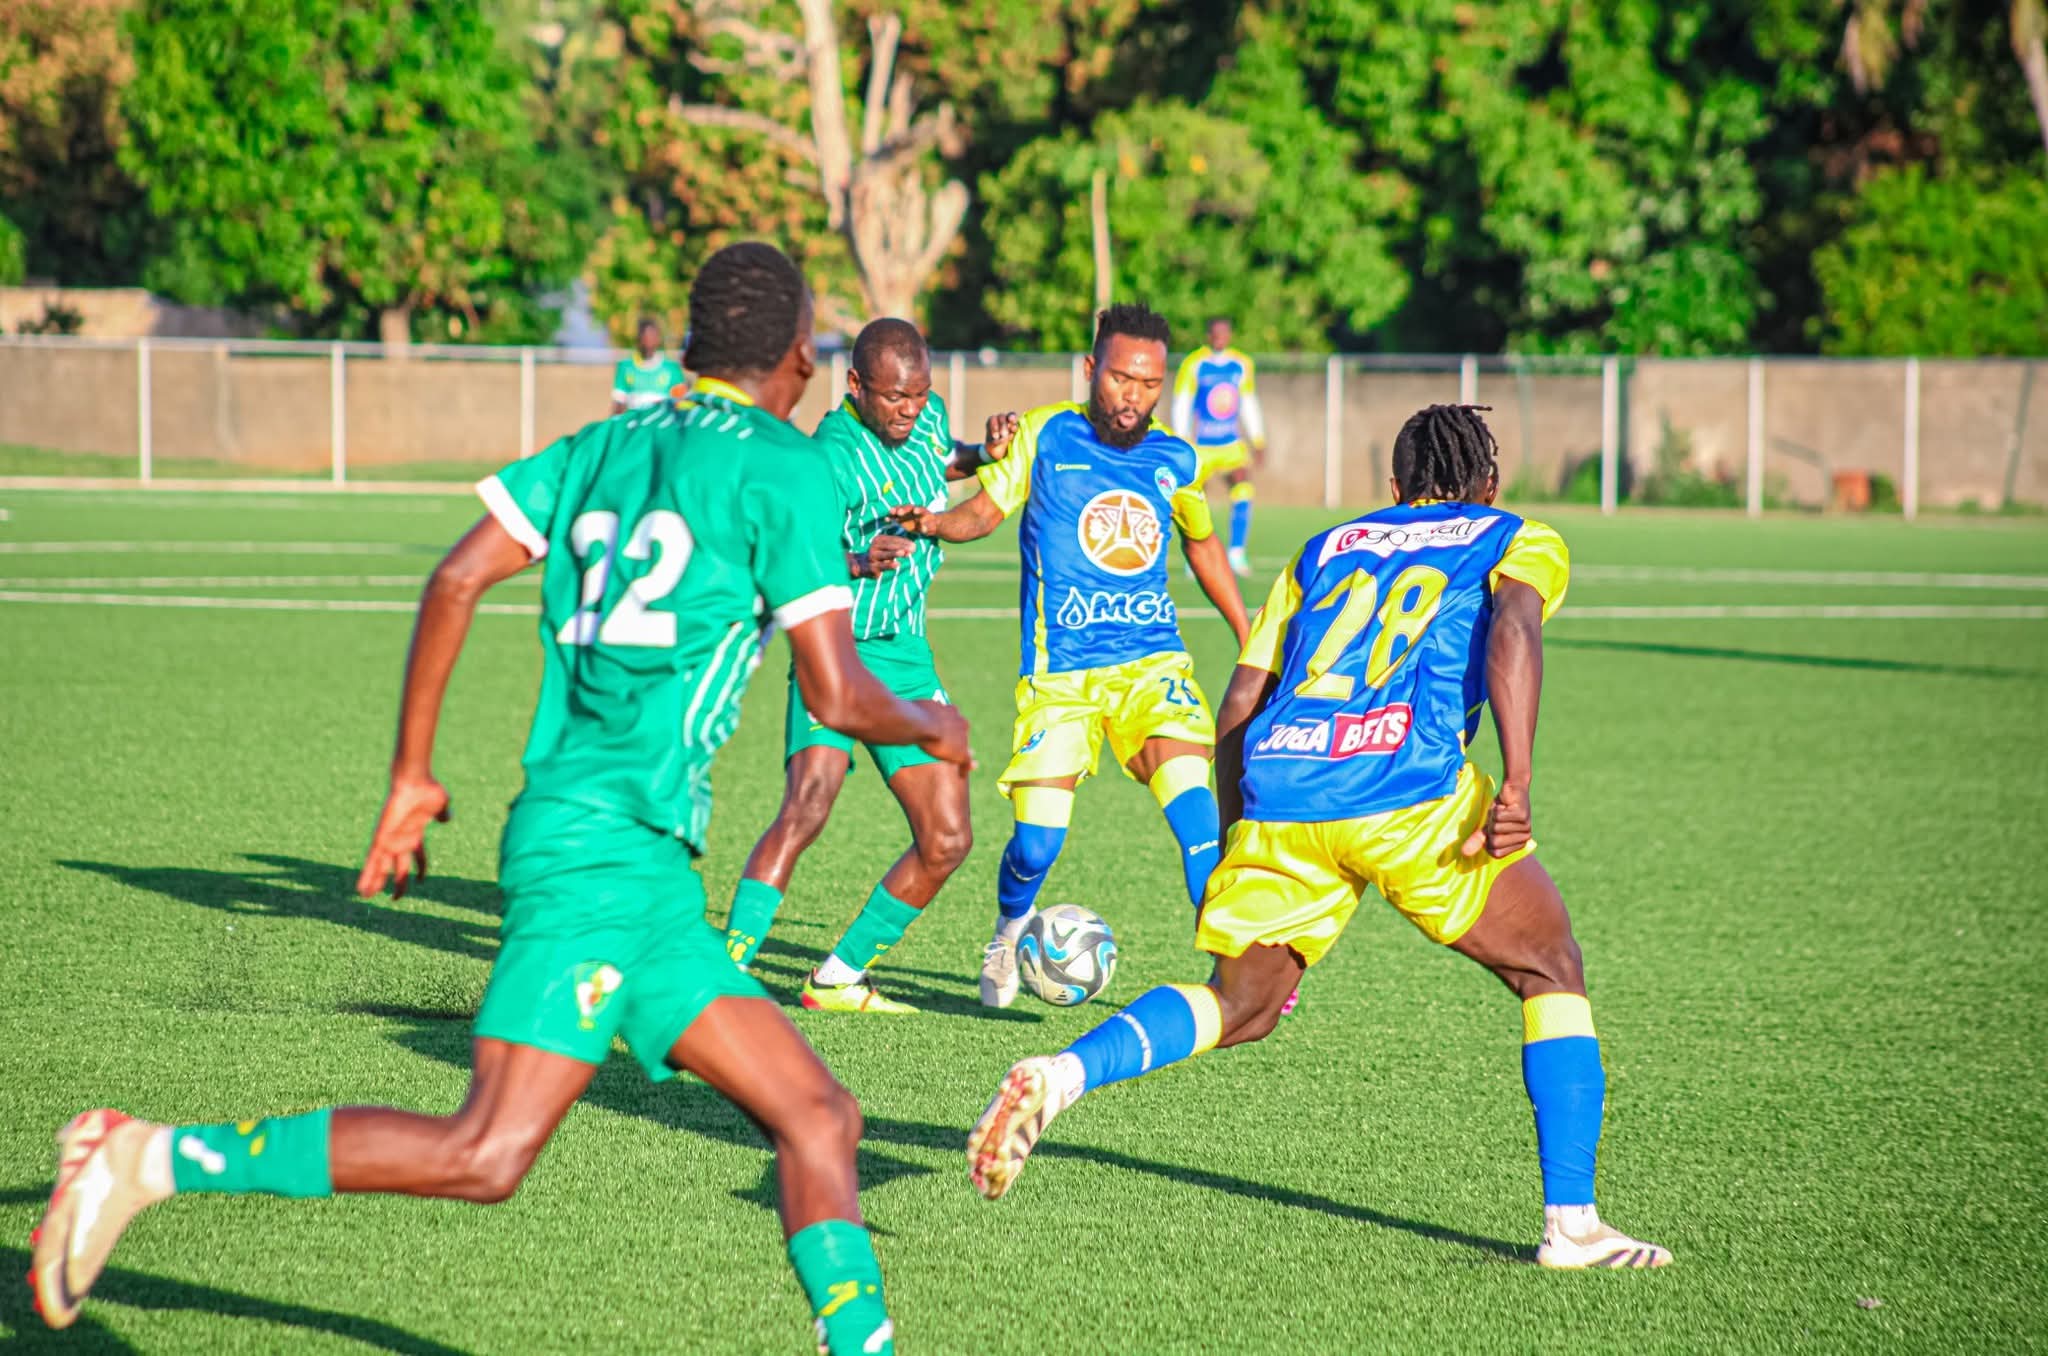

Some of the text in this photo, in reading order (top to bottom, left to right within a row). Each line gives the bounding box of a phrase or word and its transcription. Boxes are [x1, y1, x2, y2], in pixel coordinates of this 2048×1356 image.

[556, 509, 694, 648] 22
[1294, 564, 1449, 701] 28
[1257, 711, 1408, 752] JOGA BETS
